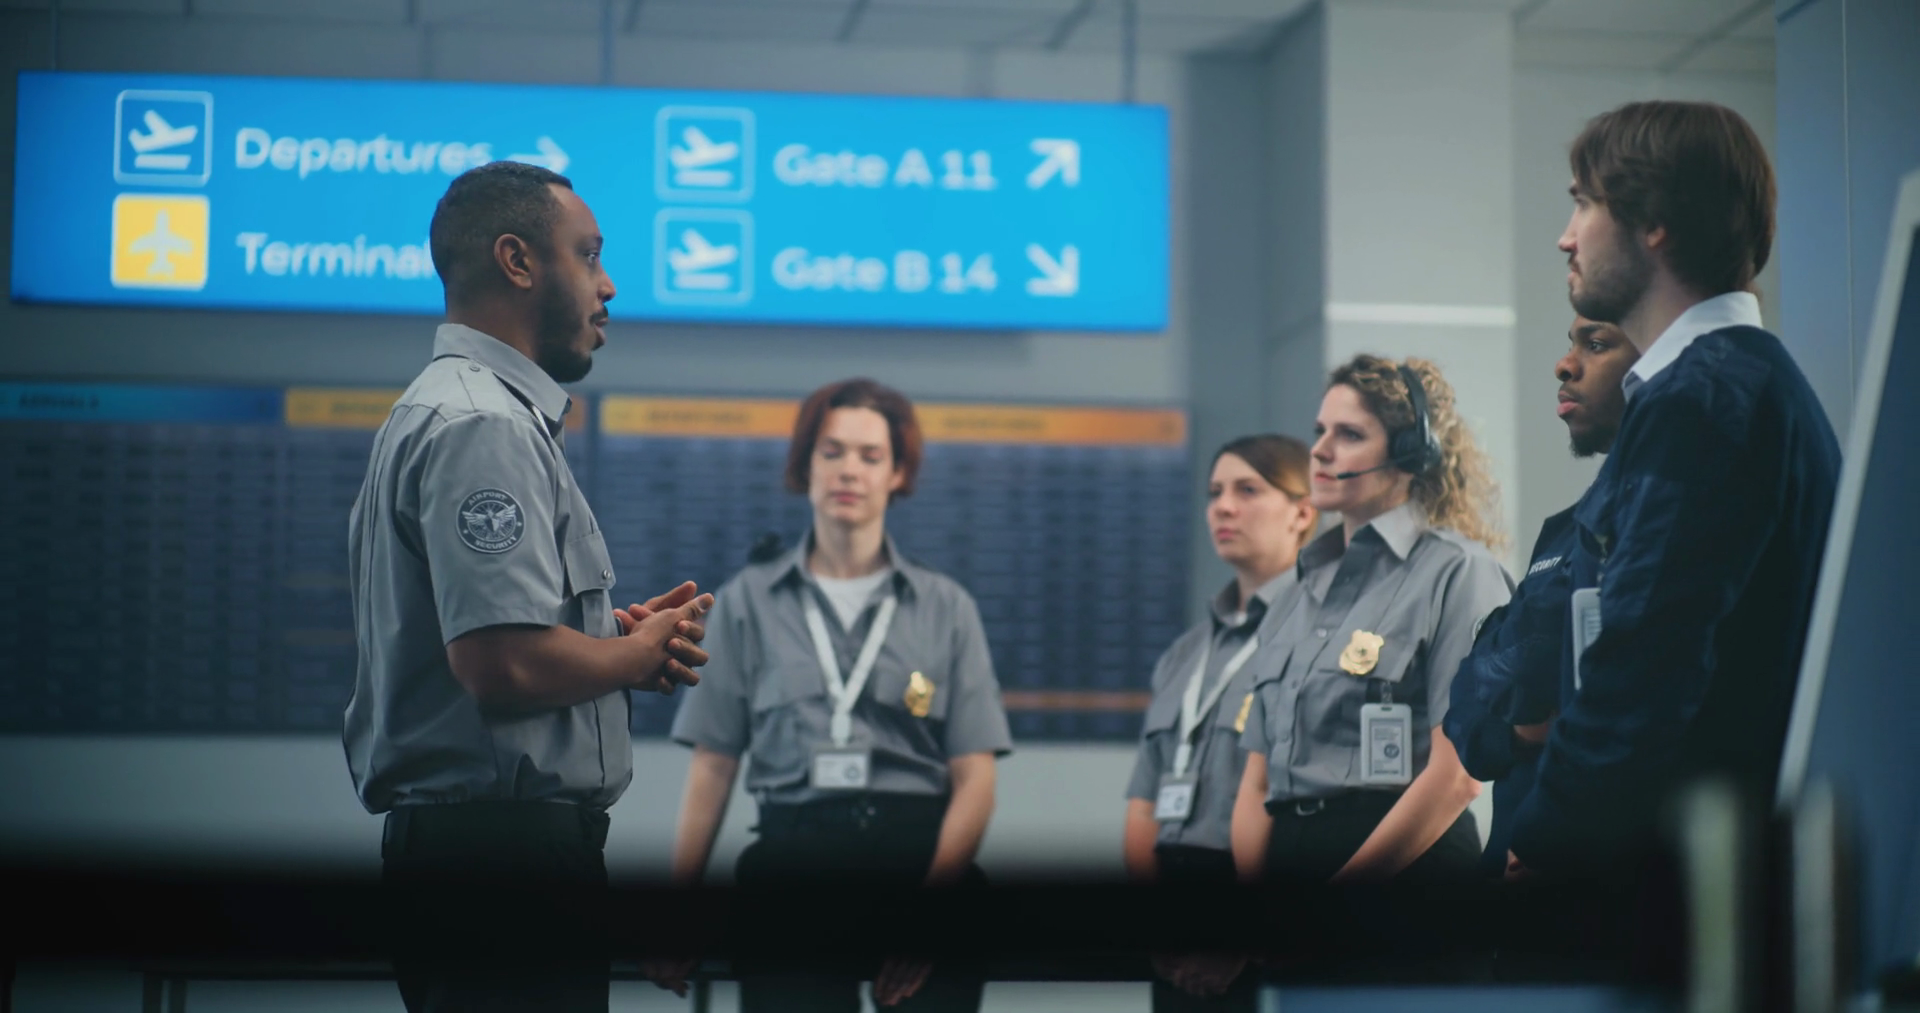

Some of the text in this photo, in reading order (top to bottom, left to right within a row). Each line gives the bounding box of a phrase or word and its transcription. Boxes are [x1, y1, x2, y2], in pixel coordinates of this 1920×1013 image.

[235, 127, 494, 178] Departures
[773, 144, 997, 190] Gate A 11
[237, 231, 433, 278] Terminal
[771, 247, 998, 294] Gate B 14
[468, 491, 507, 505] AIRPORT
[475, 535, 516, 549] SECURITY
